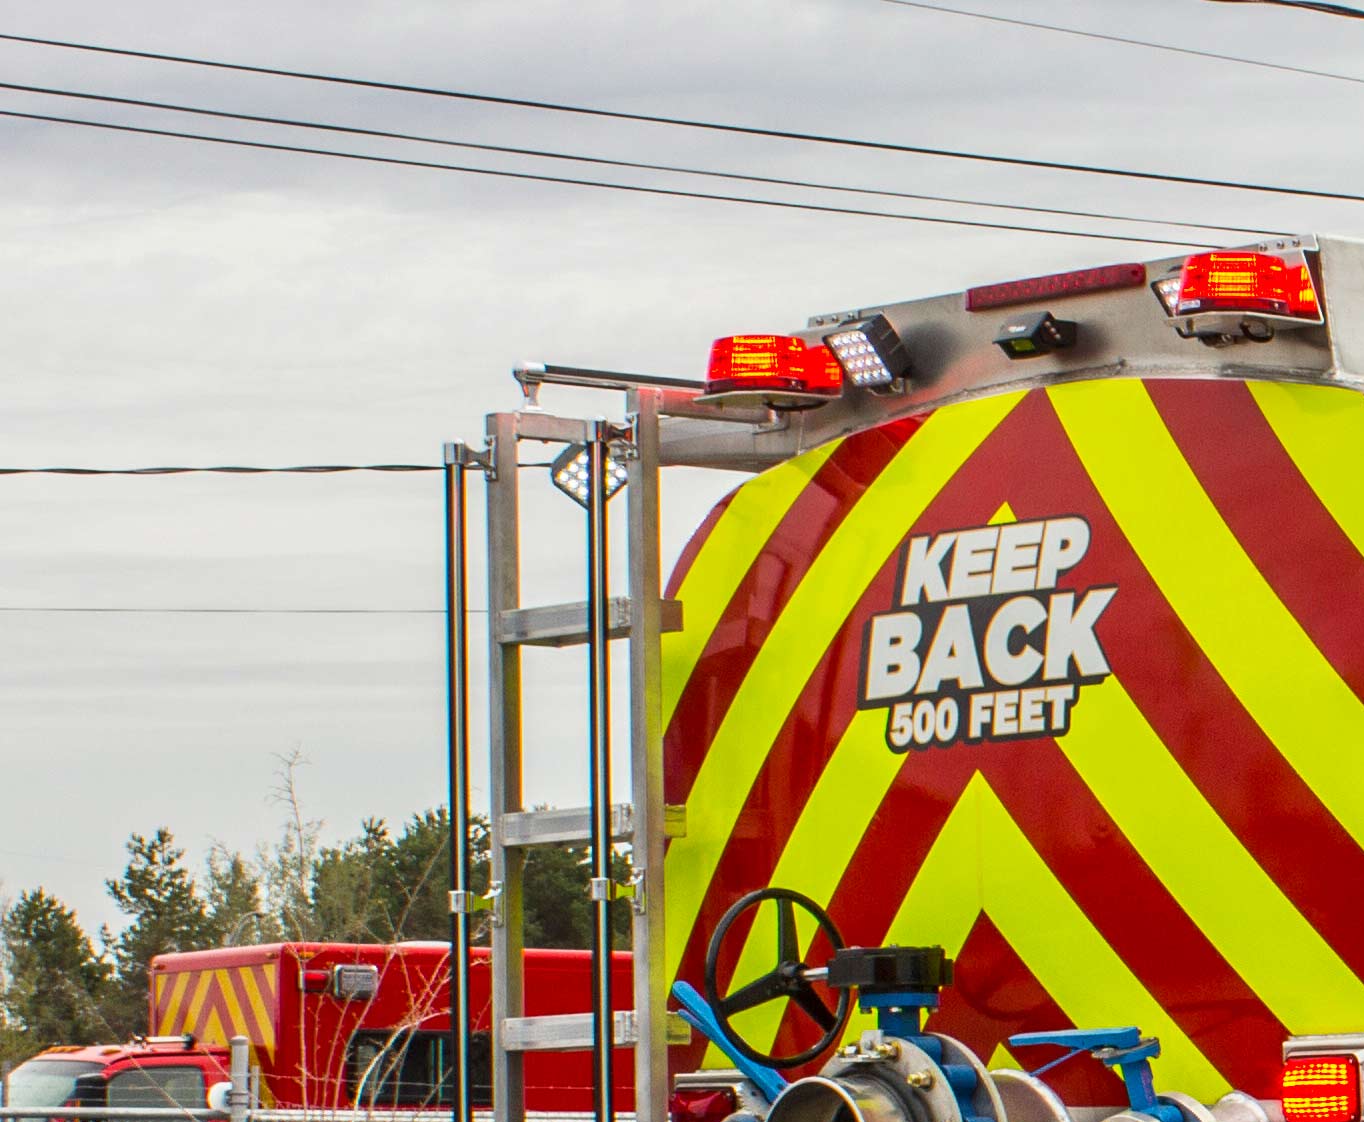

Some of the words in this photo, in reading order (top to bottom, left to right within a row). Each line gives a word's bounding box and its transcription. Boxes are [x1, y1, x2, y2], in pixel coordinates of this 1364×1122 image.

[900, 516, 1091, 607] KEEP
[865, 586, 1119, 701] BACK
[889, 697, 959, 747] 500
[968, 684, 1075, 739] FEET
